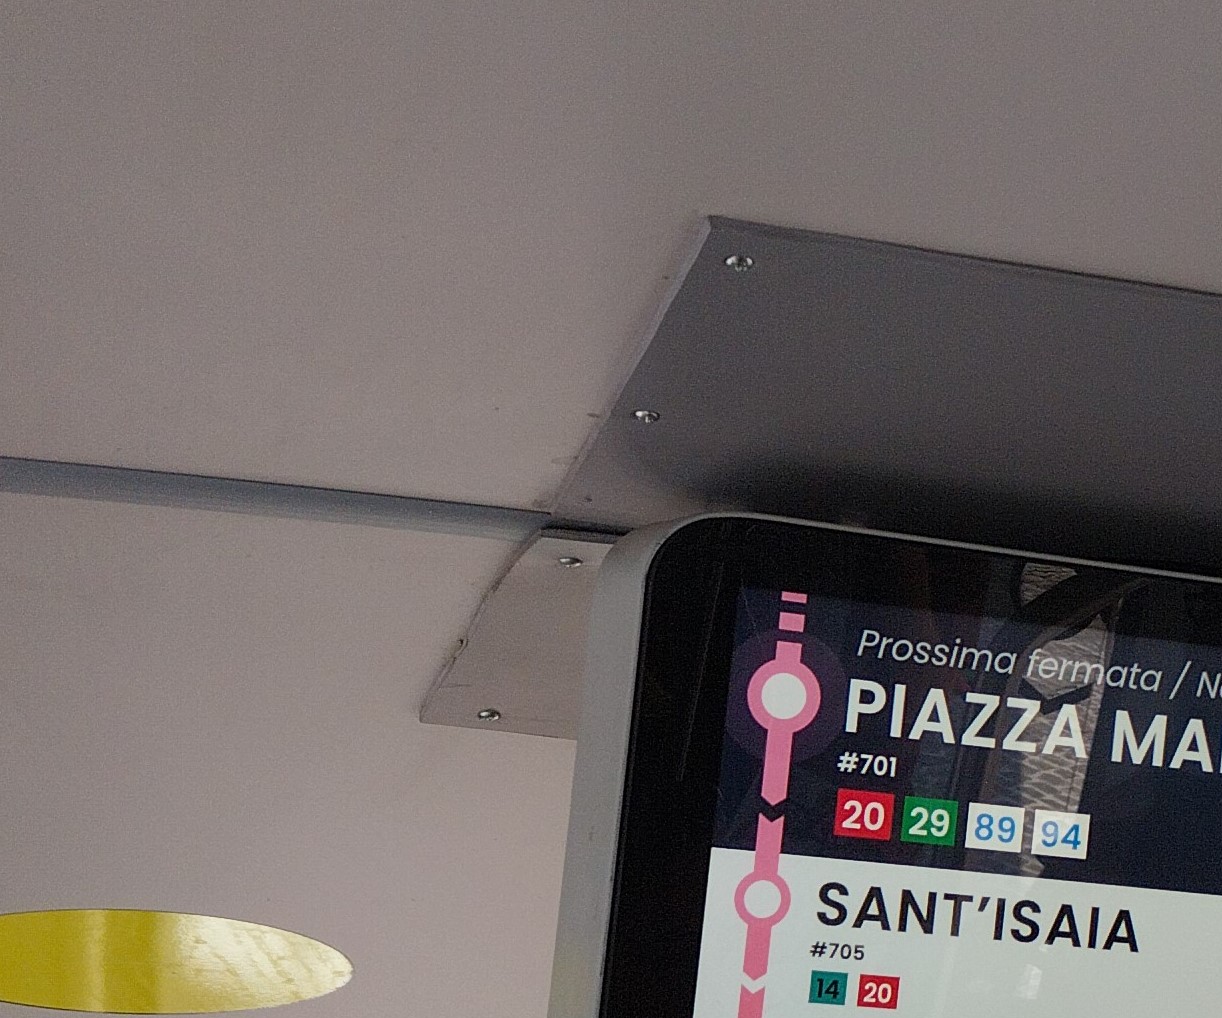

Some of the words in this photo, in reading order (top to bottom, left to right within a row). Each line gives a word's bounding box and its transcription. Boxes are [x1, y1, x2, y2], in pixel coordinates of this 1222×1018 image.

[857, 629, 1017, 676] Prossima
[1027, 648, 1162, 694] fermata
[1169, 660, 1192, 700] /
[844, 678, 1089, 760] PIAZZA
[837, 751, 898, 778] #701
[842, 800, 886, 832] 20
[910, 807, 951, 837] 29
[974, 813, 1017, 843] 89
[1041, 821, 1082, 851] 94
[816, 881, 1140, 953] SANT'ISAIA
[809, 941, 865, 961] #705
[816, 976, 840, 999] 14
[864, 981, 893, 1004] 20
